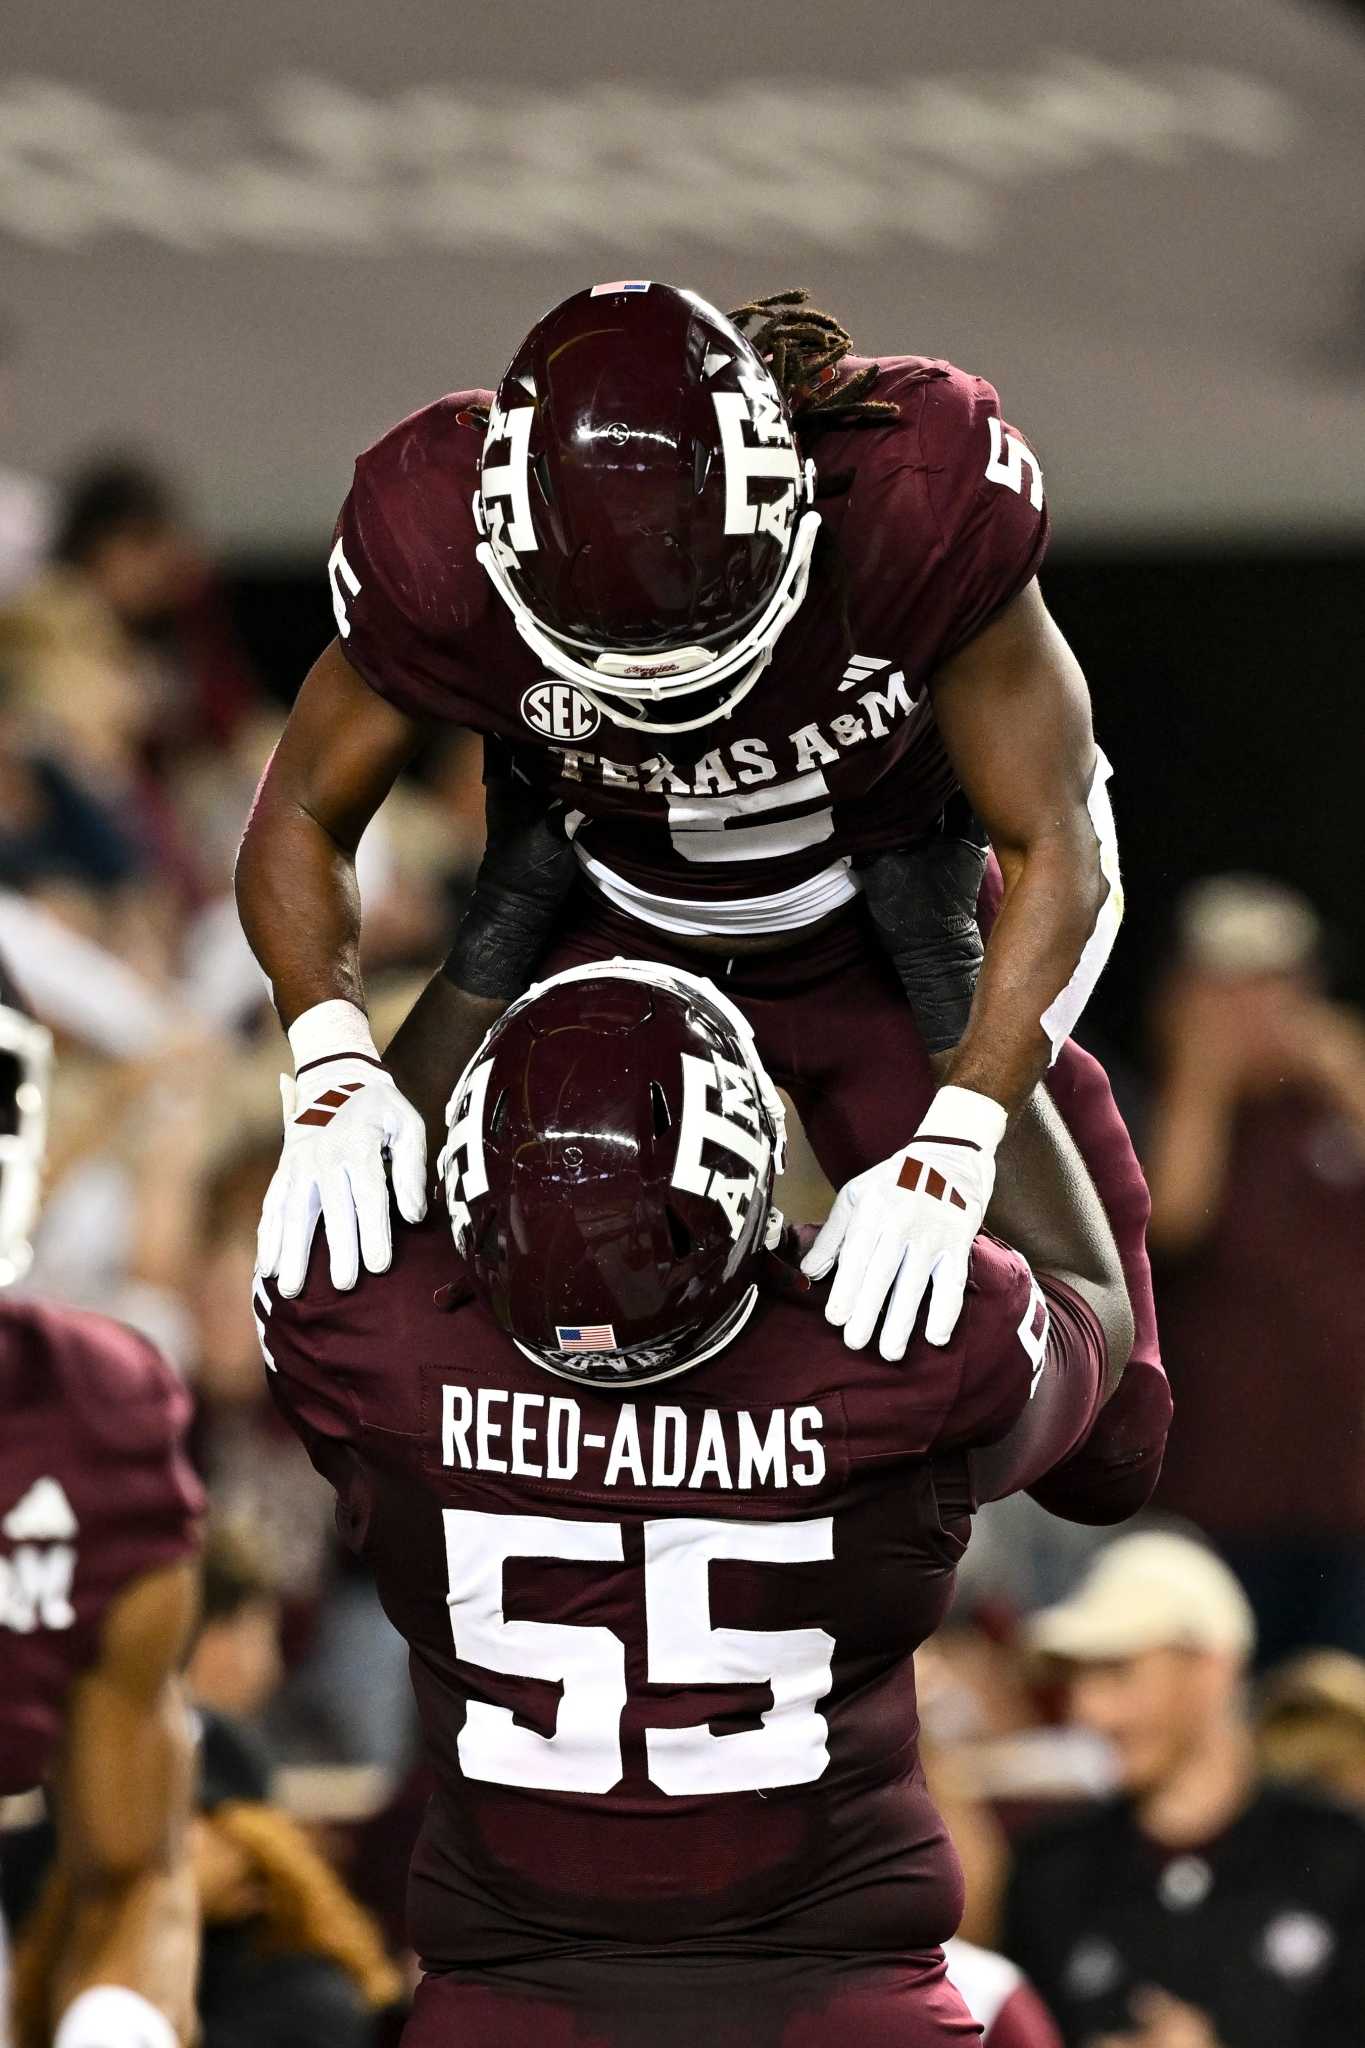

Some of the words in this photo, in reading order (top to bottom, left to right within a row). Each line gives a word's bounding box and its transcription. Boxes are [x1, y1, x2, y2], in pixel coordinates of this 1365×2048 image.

[985, 416, 1043, 512] 5
[527, 685, 593, 737] SEC
[548, 738, 778, 795] TEXAS
[788, 670, 919, 772] A&M
[441, 1384, 827, 1491] REED-ADAMS
[441, 1508, 835, 1797] 55
